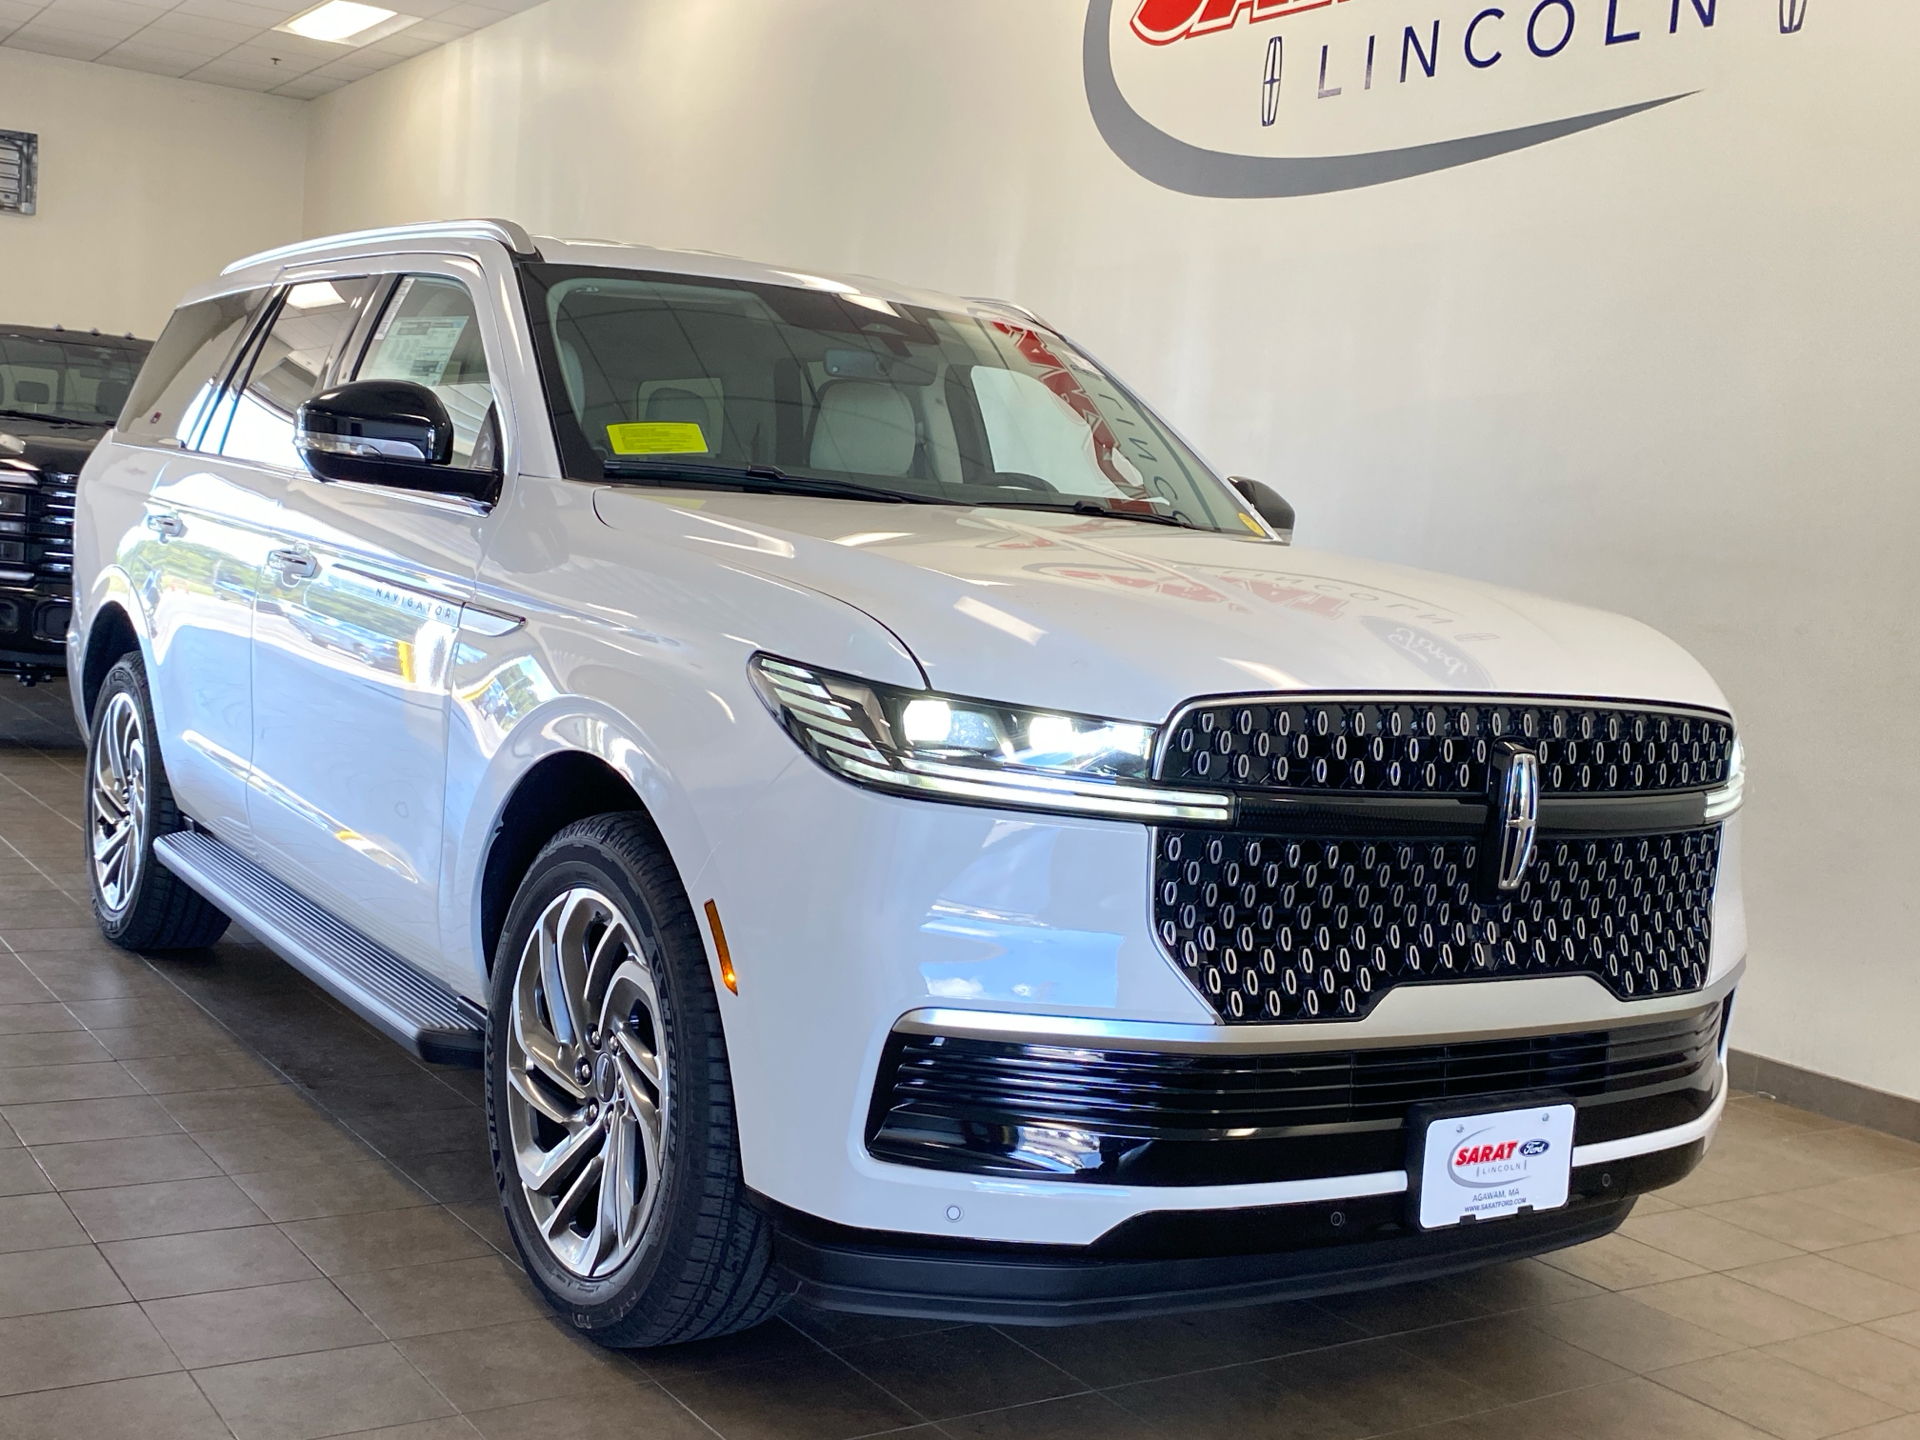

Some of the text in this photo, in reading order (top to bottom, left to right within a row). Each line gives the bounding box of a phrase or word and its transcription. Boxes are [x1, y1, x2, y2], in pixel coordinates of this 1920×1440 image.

[375, 588, 452, 619] NAVIGATOR
[661, 997, 678, 1152] MICHELIN
[1455, 1141, 1518, 1166] SARAT
[1482, 1162, 1521, 1175] LINCOLN
[1472, 1187, 1520, 1202] AGAWAM, MA
[1464, 1198, 1526, 1212] WWW.SARATFORD.COM
